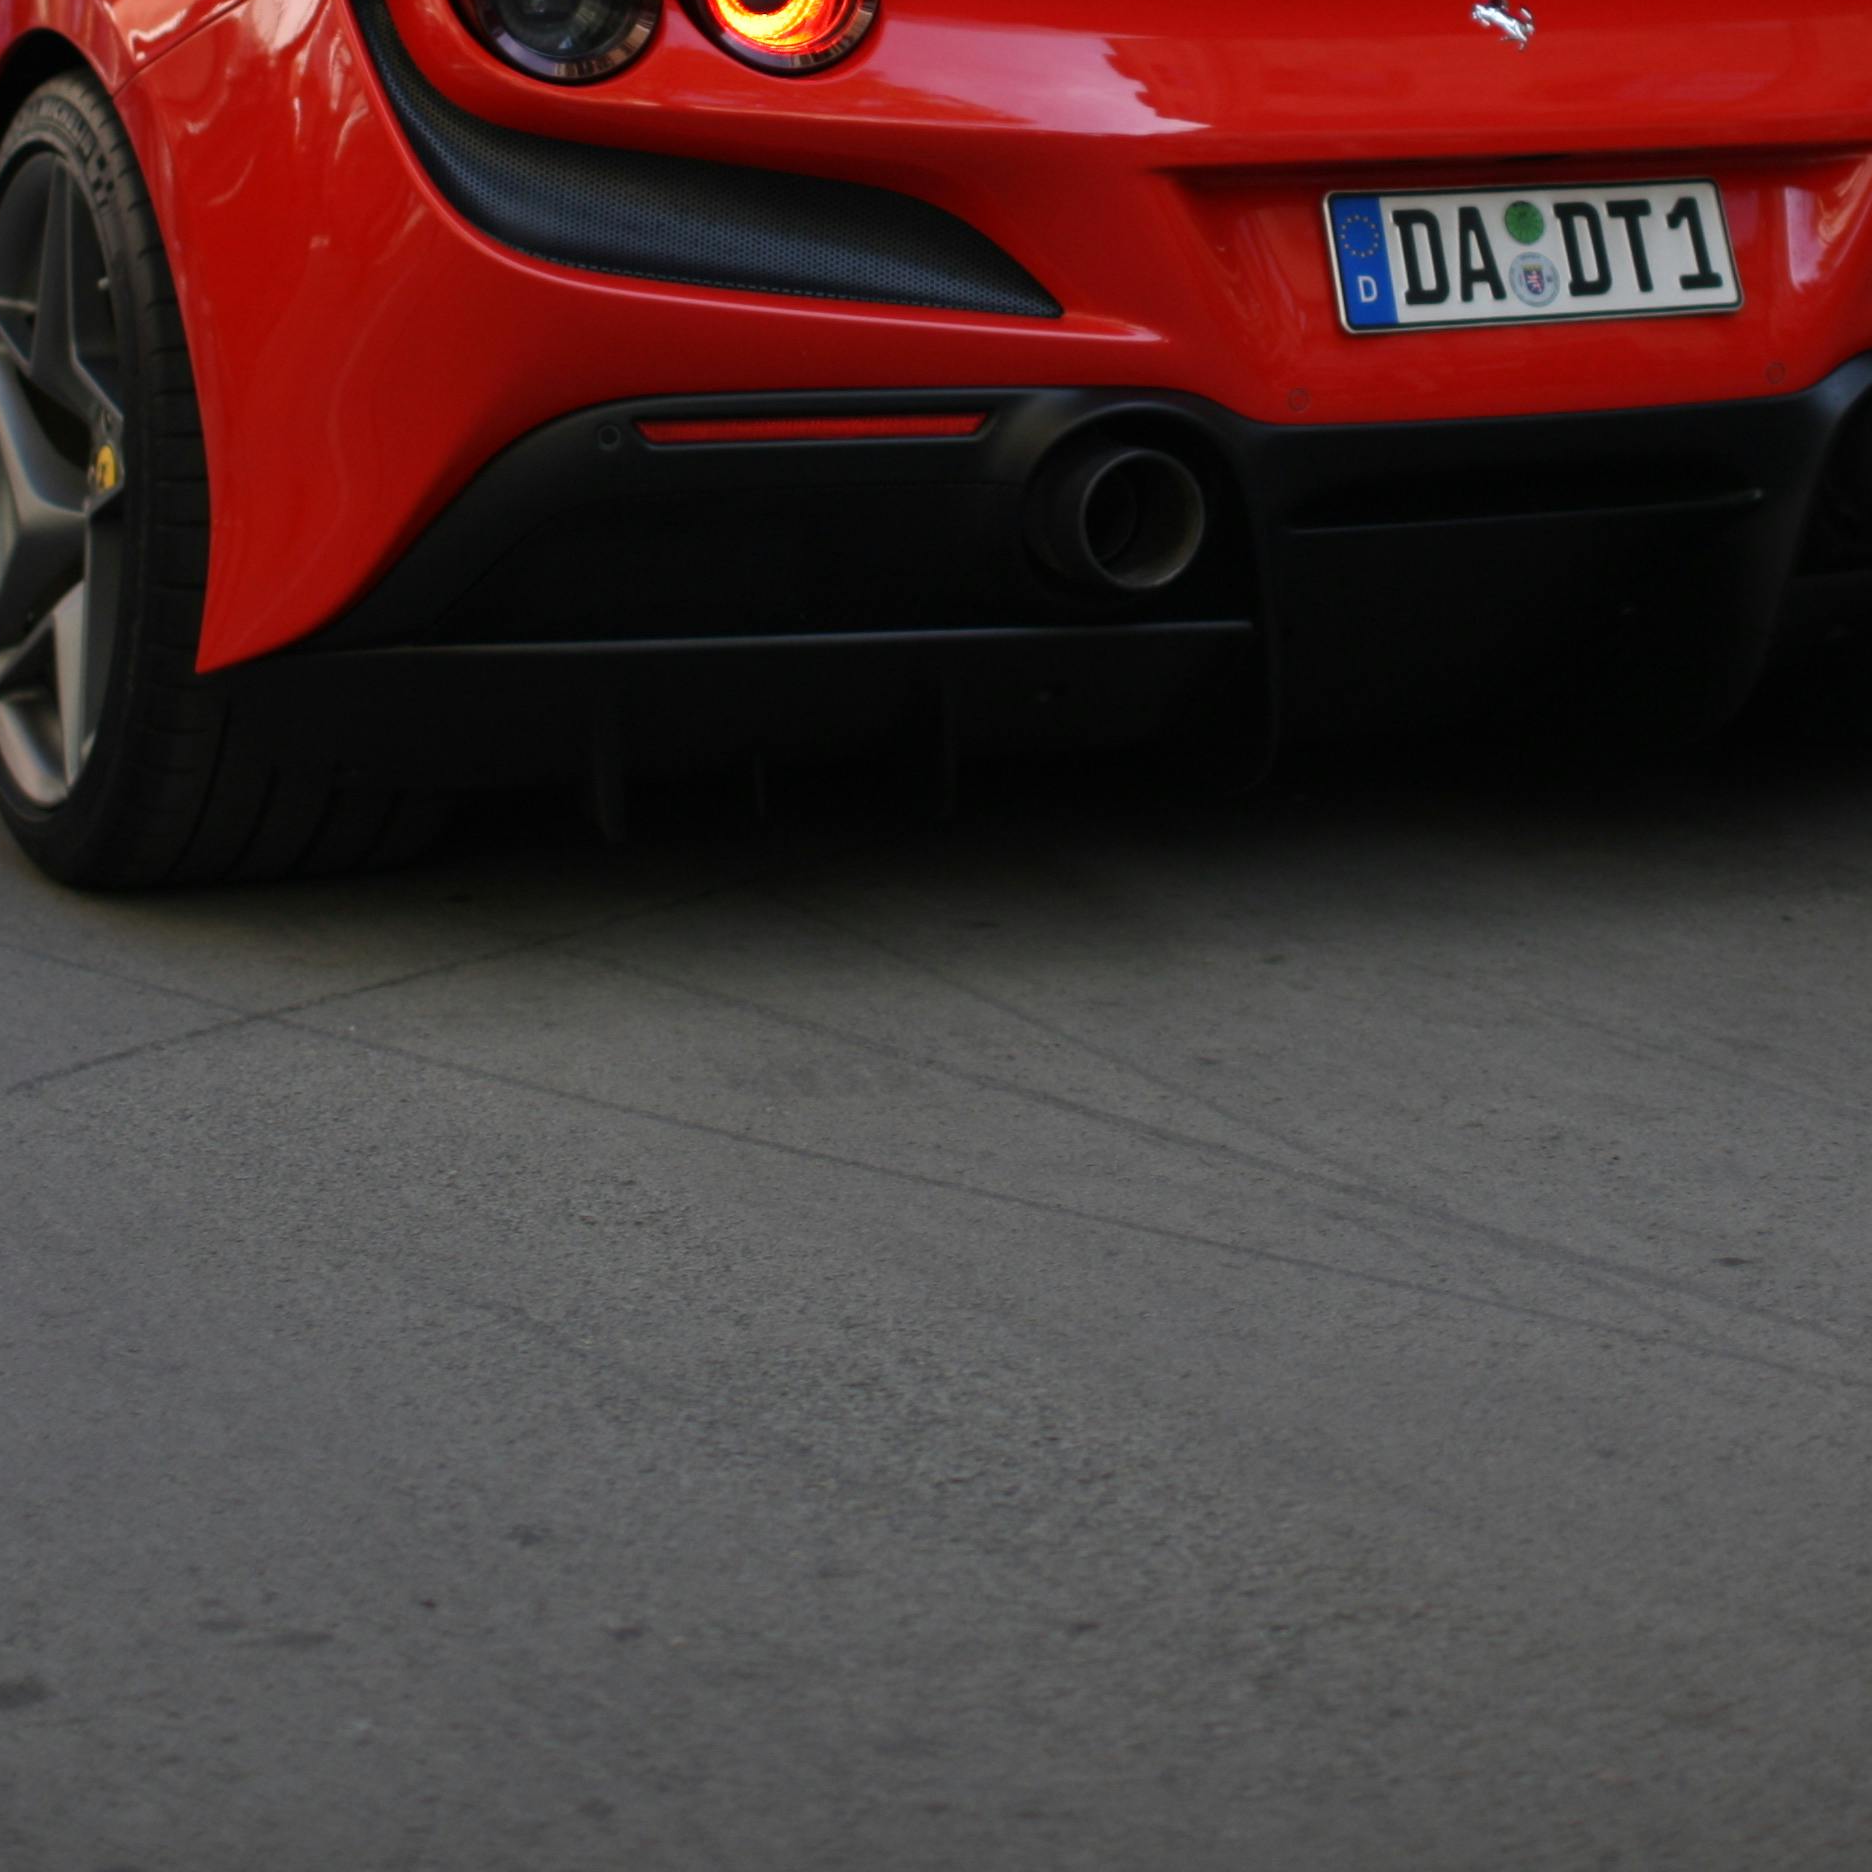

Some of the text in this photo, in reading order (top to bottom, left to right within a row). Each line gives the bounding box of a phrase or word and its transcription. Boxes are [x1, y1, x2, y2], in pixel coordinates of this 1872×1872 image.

[1392, 206, 1506, 305] DA
[1553, 196, 1724, 296] DT1
[1357, 275, 1379, 303] D
